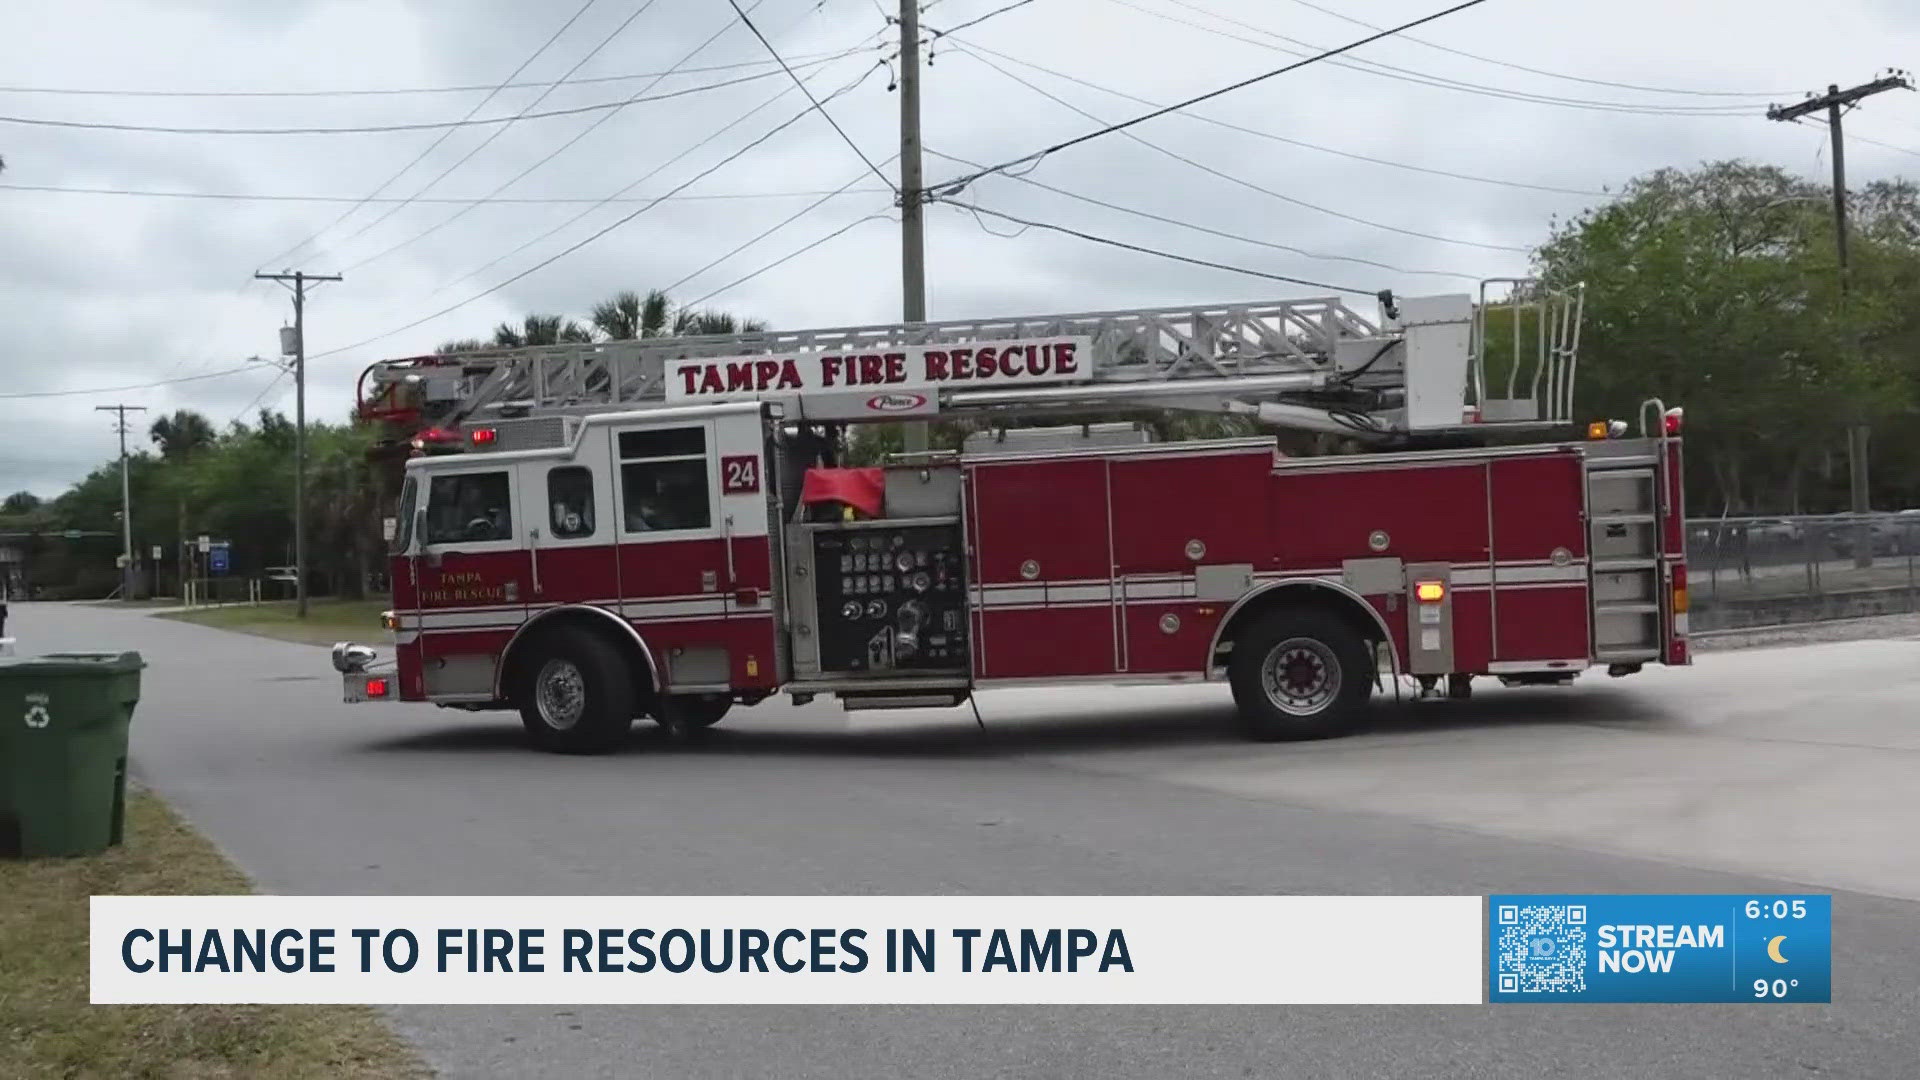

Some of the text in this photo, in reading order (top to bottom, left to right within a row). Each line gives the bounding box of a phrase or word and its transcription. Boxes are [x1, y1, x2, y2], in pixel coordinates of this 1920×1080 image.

[678, 342, 1078, 395] TAMPA FIRE RESCUE
[727, 461, 756, 487] 24
[441, 572, 482, 583] TAMPA
[421, 586, 504, 601] FIRE RESCUE
